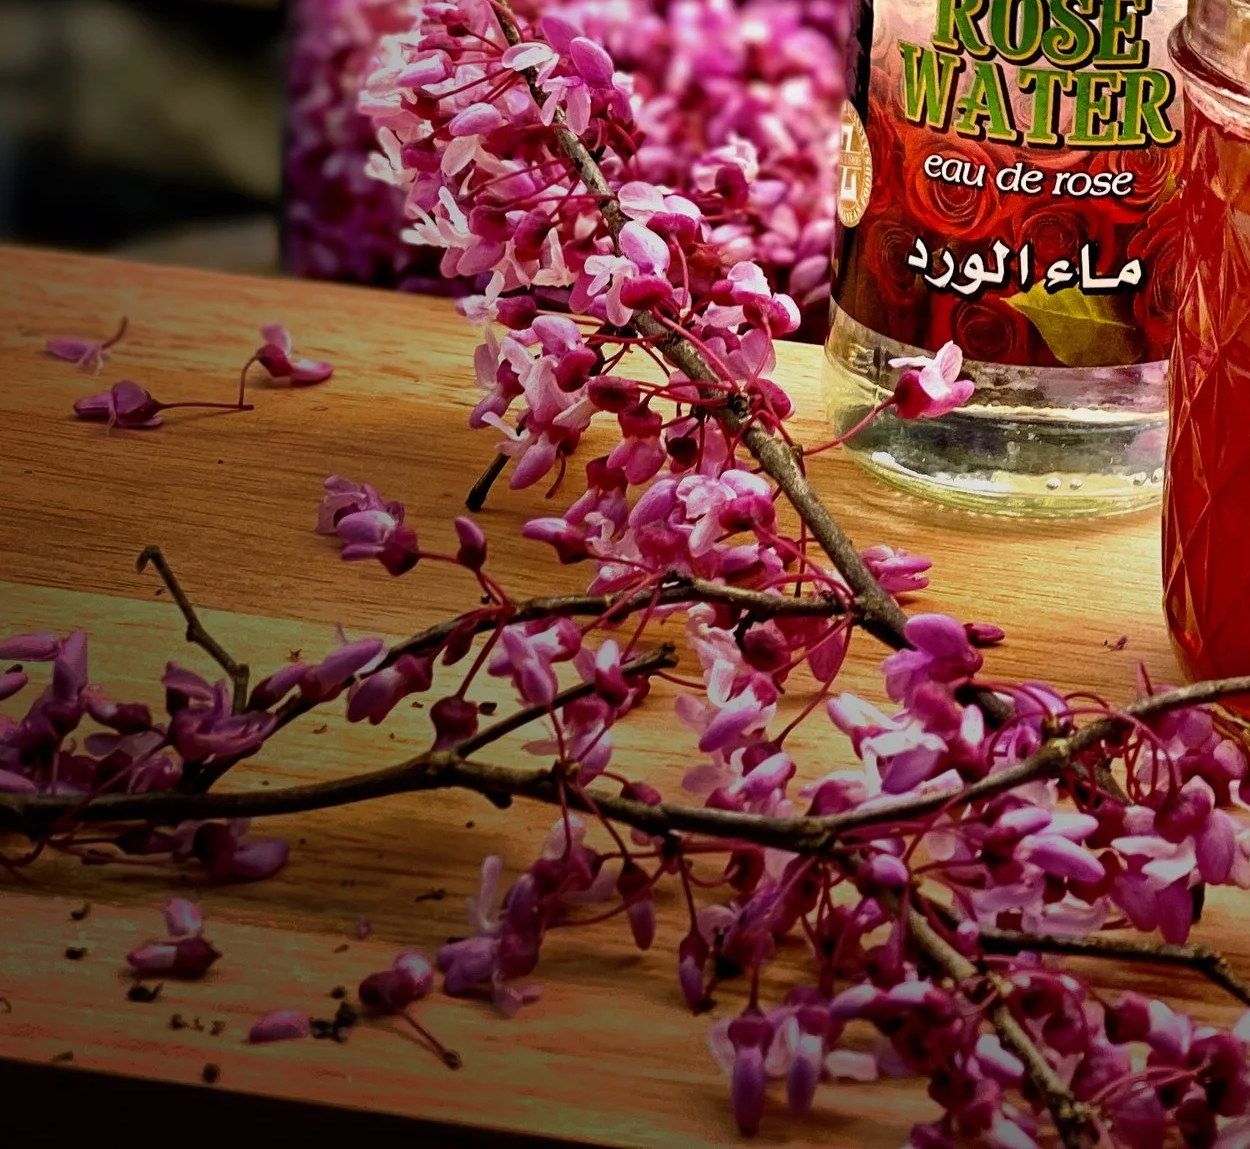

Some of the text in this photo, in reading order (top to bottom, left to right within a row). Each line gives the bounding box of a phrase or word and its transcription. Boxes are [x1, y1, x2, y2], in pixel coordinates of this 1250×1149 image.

[897, 38, 1182, 151] WATER
[923, 152, 1134, 197] eau de rose
[907, 237, 1143, 295] ماء الورد
